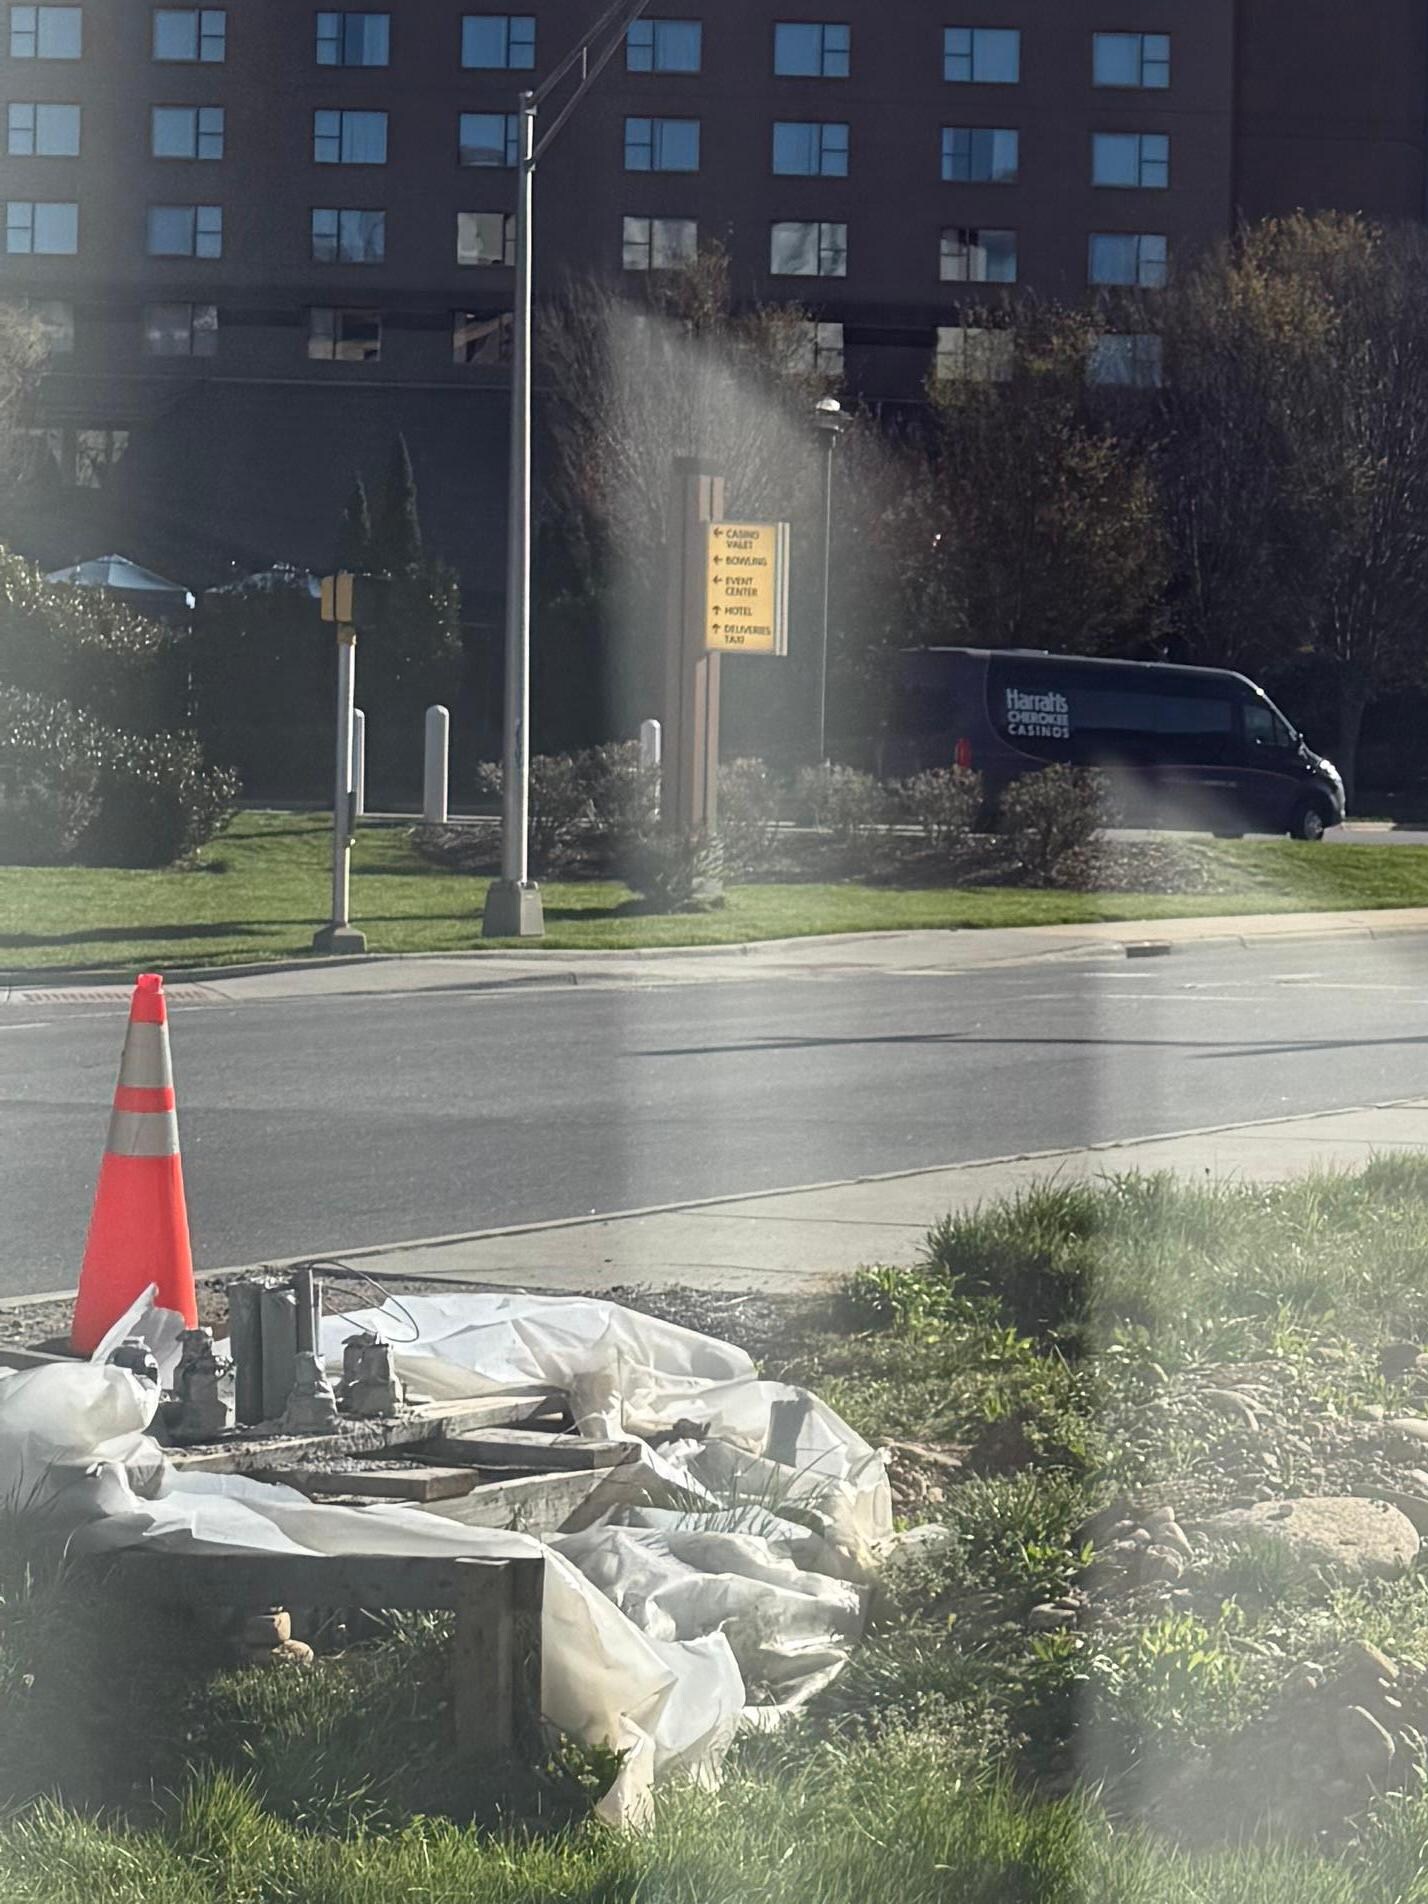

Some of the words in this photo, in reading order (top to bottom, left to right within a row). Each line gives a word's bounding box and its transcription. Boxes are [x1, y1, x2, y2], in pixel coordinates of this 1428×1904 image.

[726, 528, 760, 540] CASINO
[726, 539, 753, 549] VALET
[726, 556, 767, 567] BOWLING
[725, 576, 753, 586] EVENT
[725, 586, 758, 597] CENTER
[724, 606, 752, 616] HOTEL
[724, 624, 771, 636] DELIVERIES
[724, 635, 745, 644] TAXI
[1007, 710, 1069, 726] CHEROKEE
[1008, 723, 1070, 739] CASINOS
